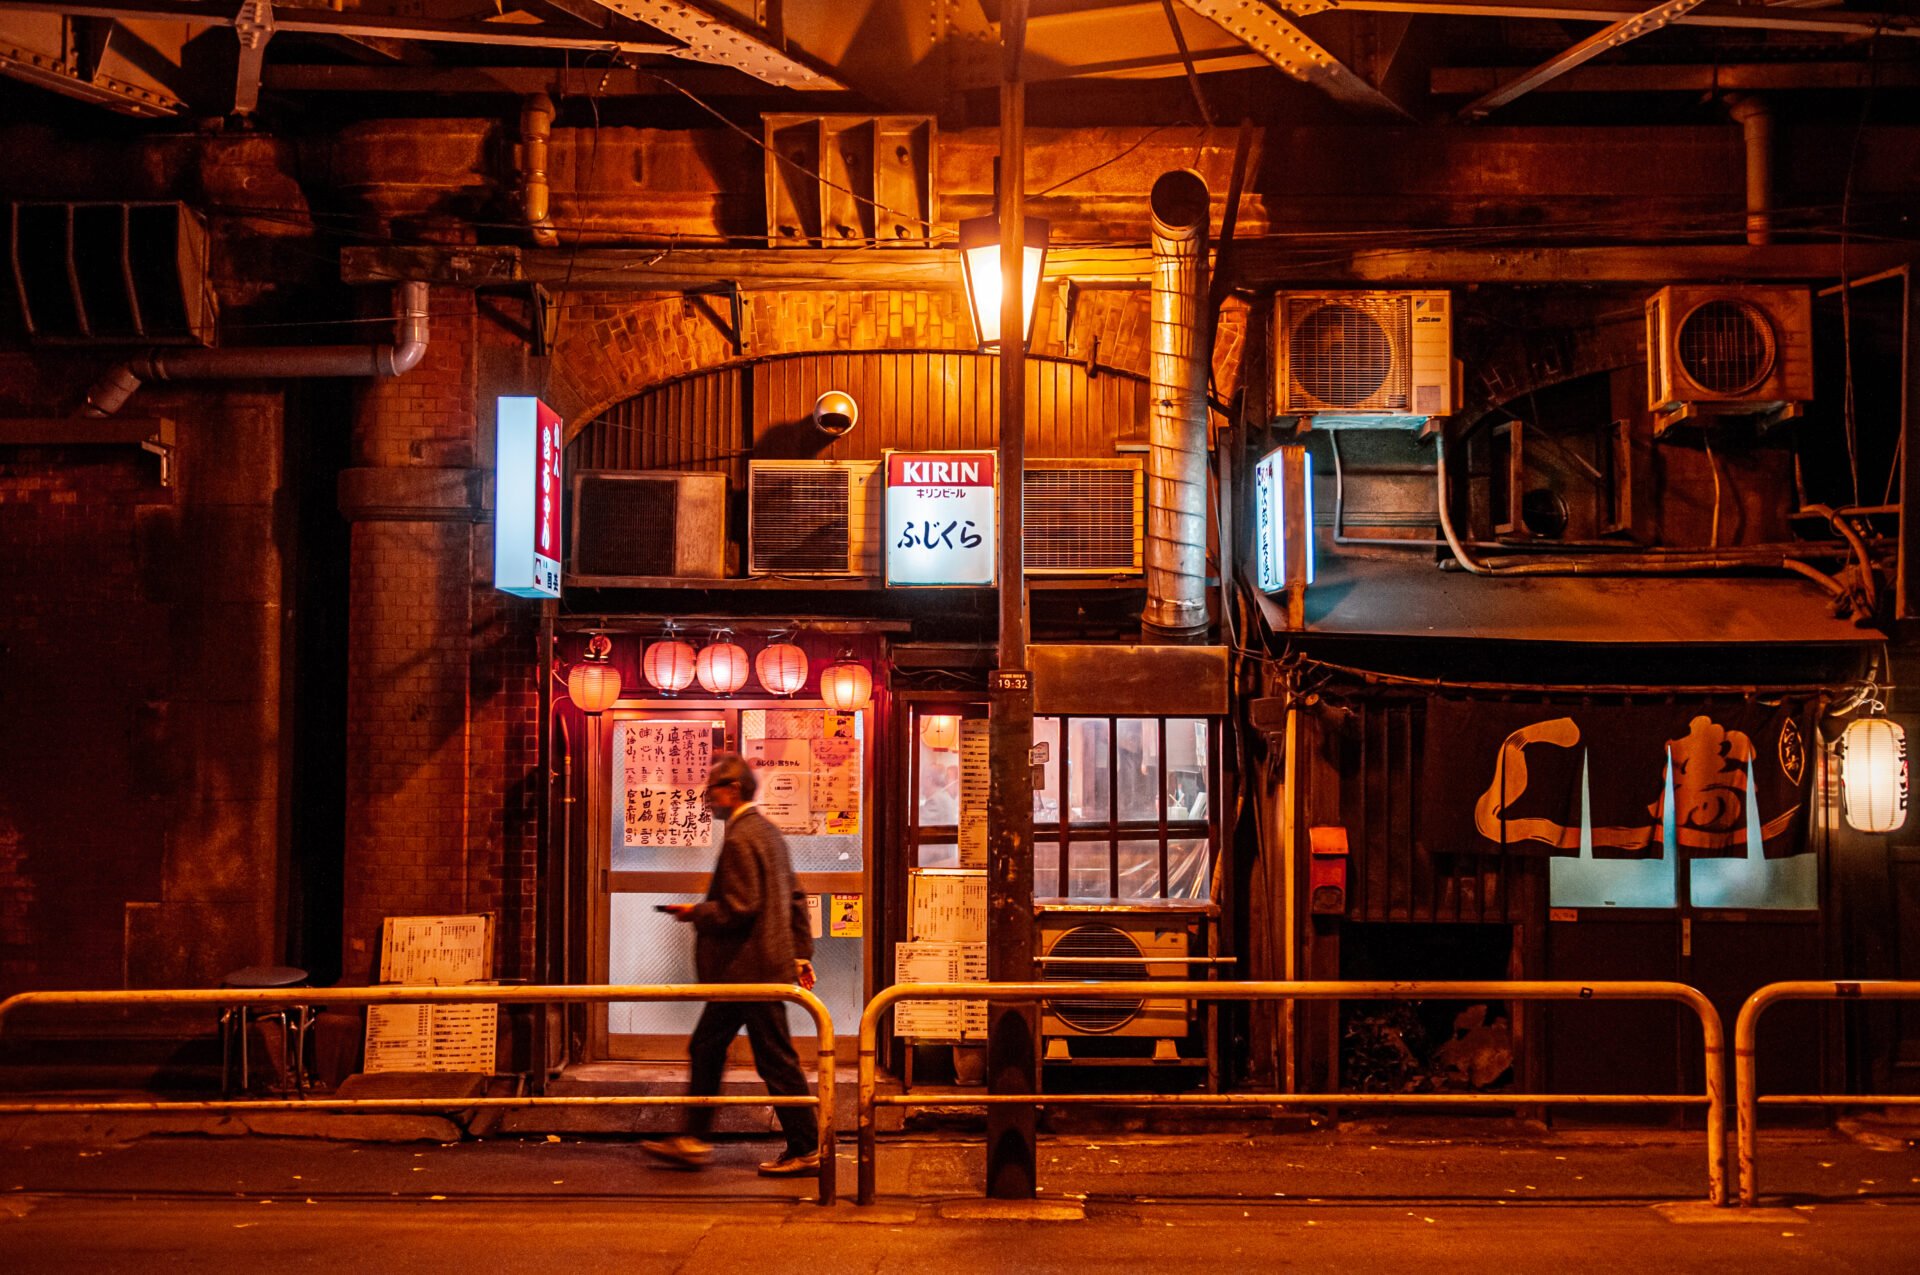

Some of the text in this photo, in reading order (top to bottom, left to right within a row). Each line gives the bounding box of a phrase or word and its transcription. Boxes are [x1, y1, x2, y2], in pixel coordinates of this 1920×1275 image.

[903, 461, 979, 483] KIRIN
[916, 488, 966, 498] キリンビール
[897, 520, 982, 549] ふじくら
[998, 679, 1027, 689] 19-32
[625, 727, 637, 756] 八海山
[637, 787, 653, 822] 山田錦
[681, 788, 697, 830] 景虎
